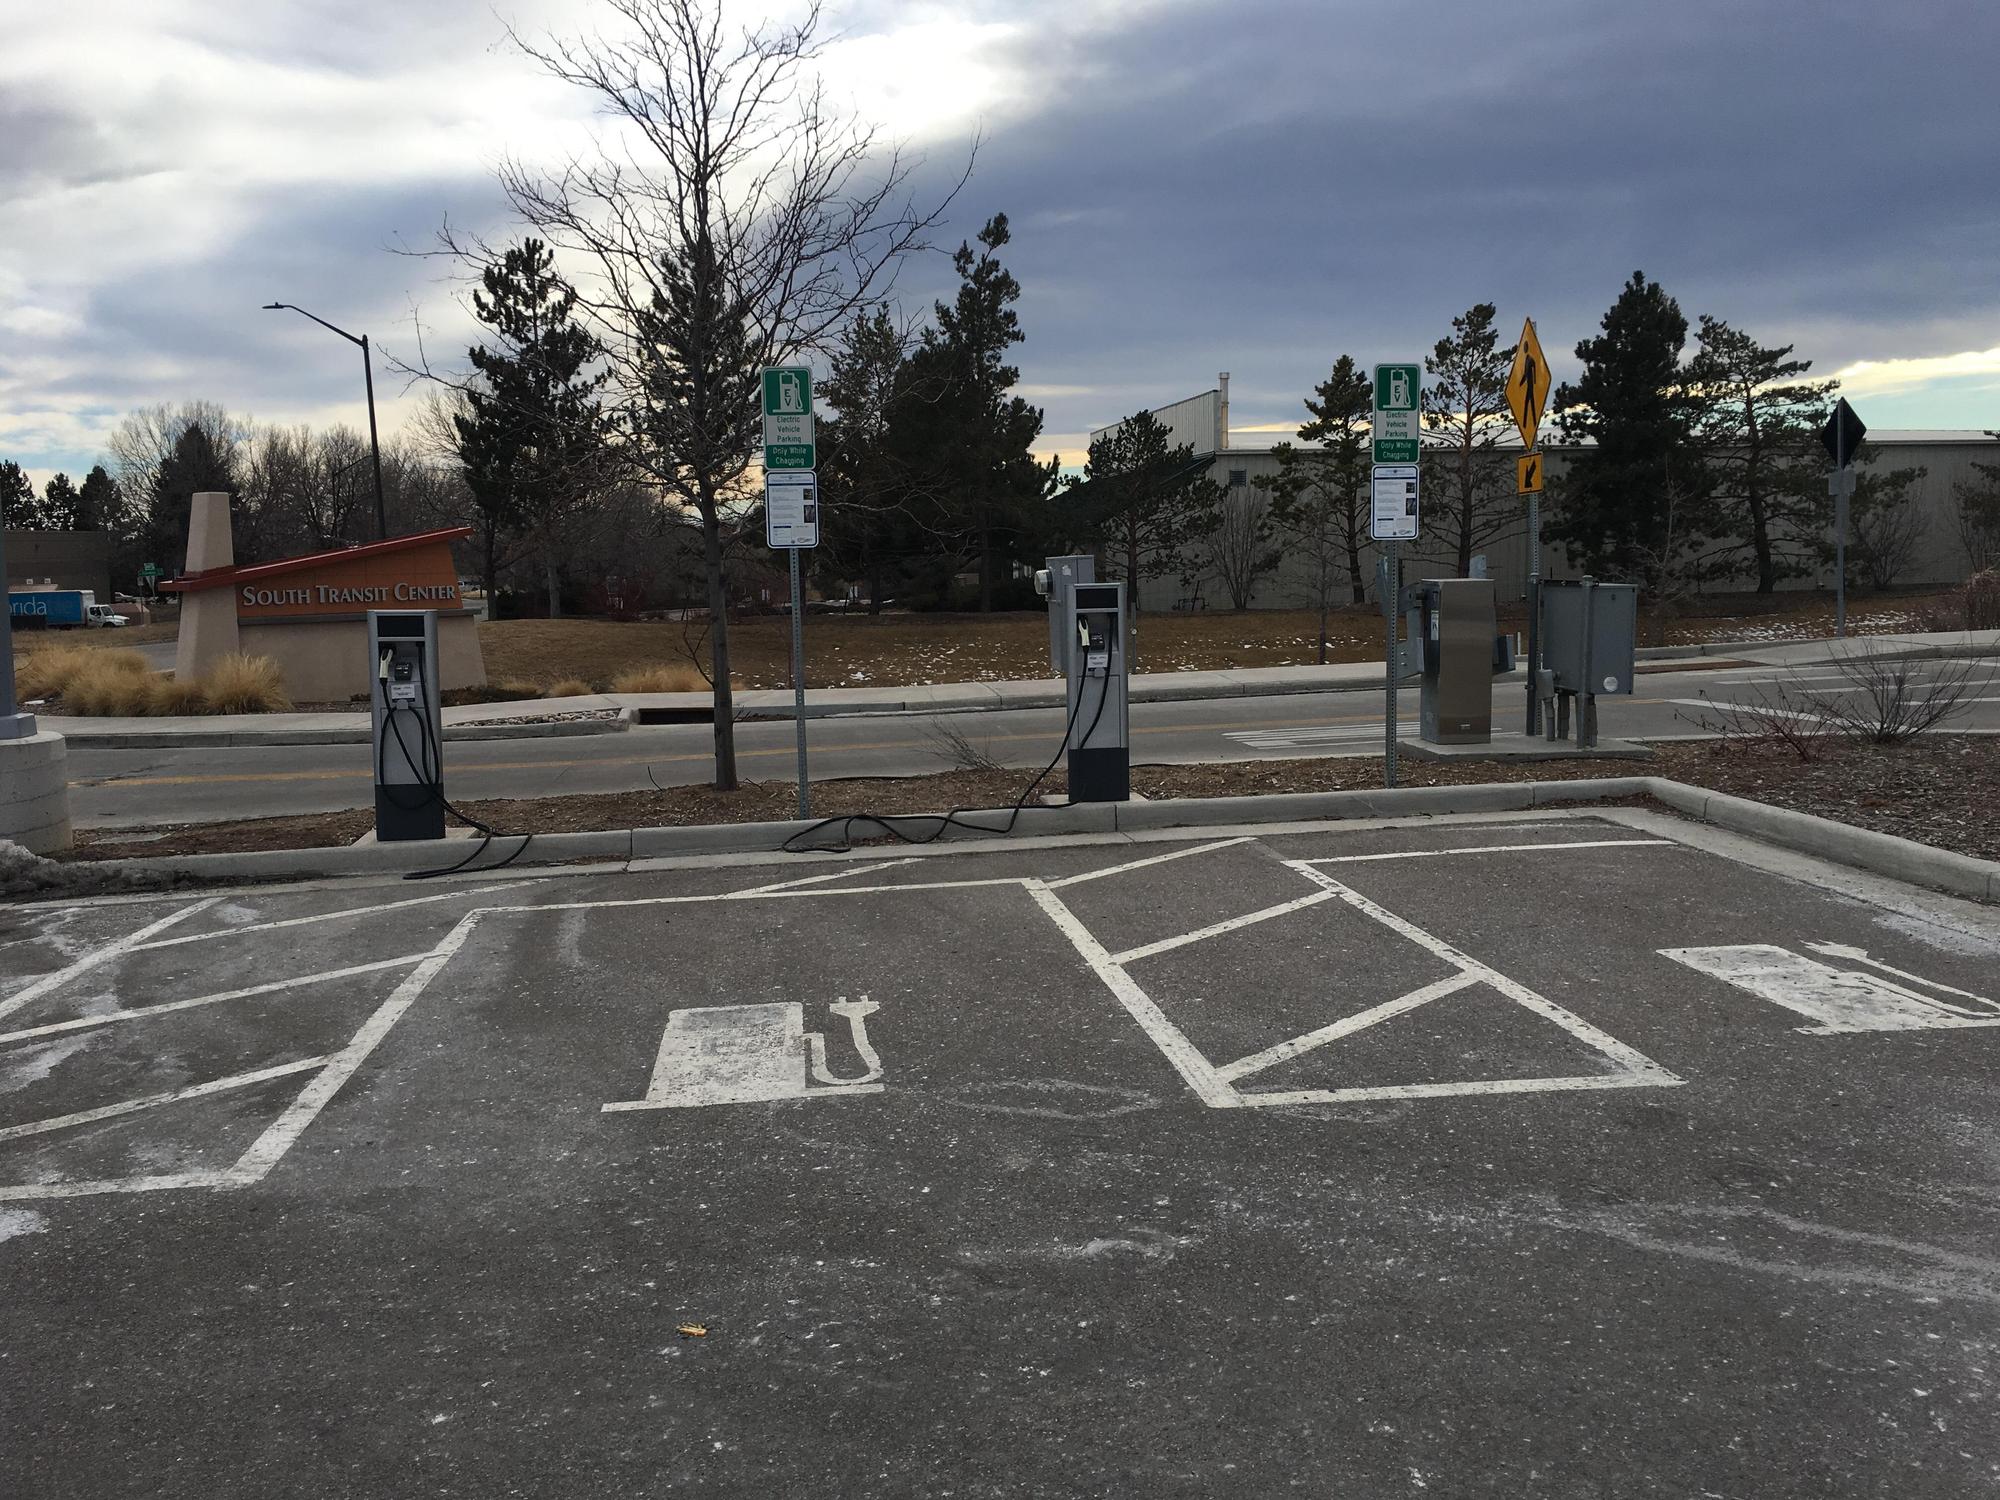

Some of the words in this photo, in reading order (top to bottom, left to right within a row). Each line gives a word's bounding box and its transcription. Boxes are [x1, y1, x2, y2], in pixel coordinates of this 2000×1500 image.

[777, 425, 800, 433] Vehicle
[1385, 430, 1408, 438] Parking
[777, 435, 802, 444] Parking
[1381, 441, 1394, 450] Only
[772, 446, 788, 456] Only
[789, 446, 807, 455] While
[242, 585, 311, 606] SOUTH
[316, 584, 389, 603] TRANSIT
[394, 582, 456, 600] CENTER
